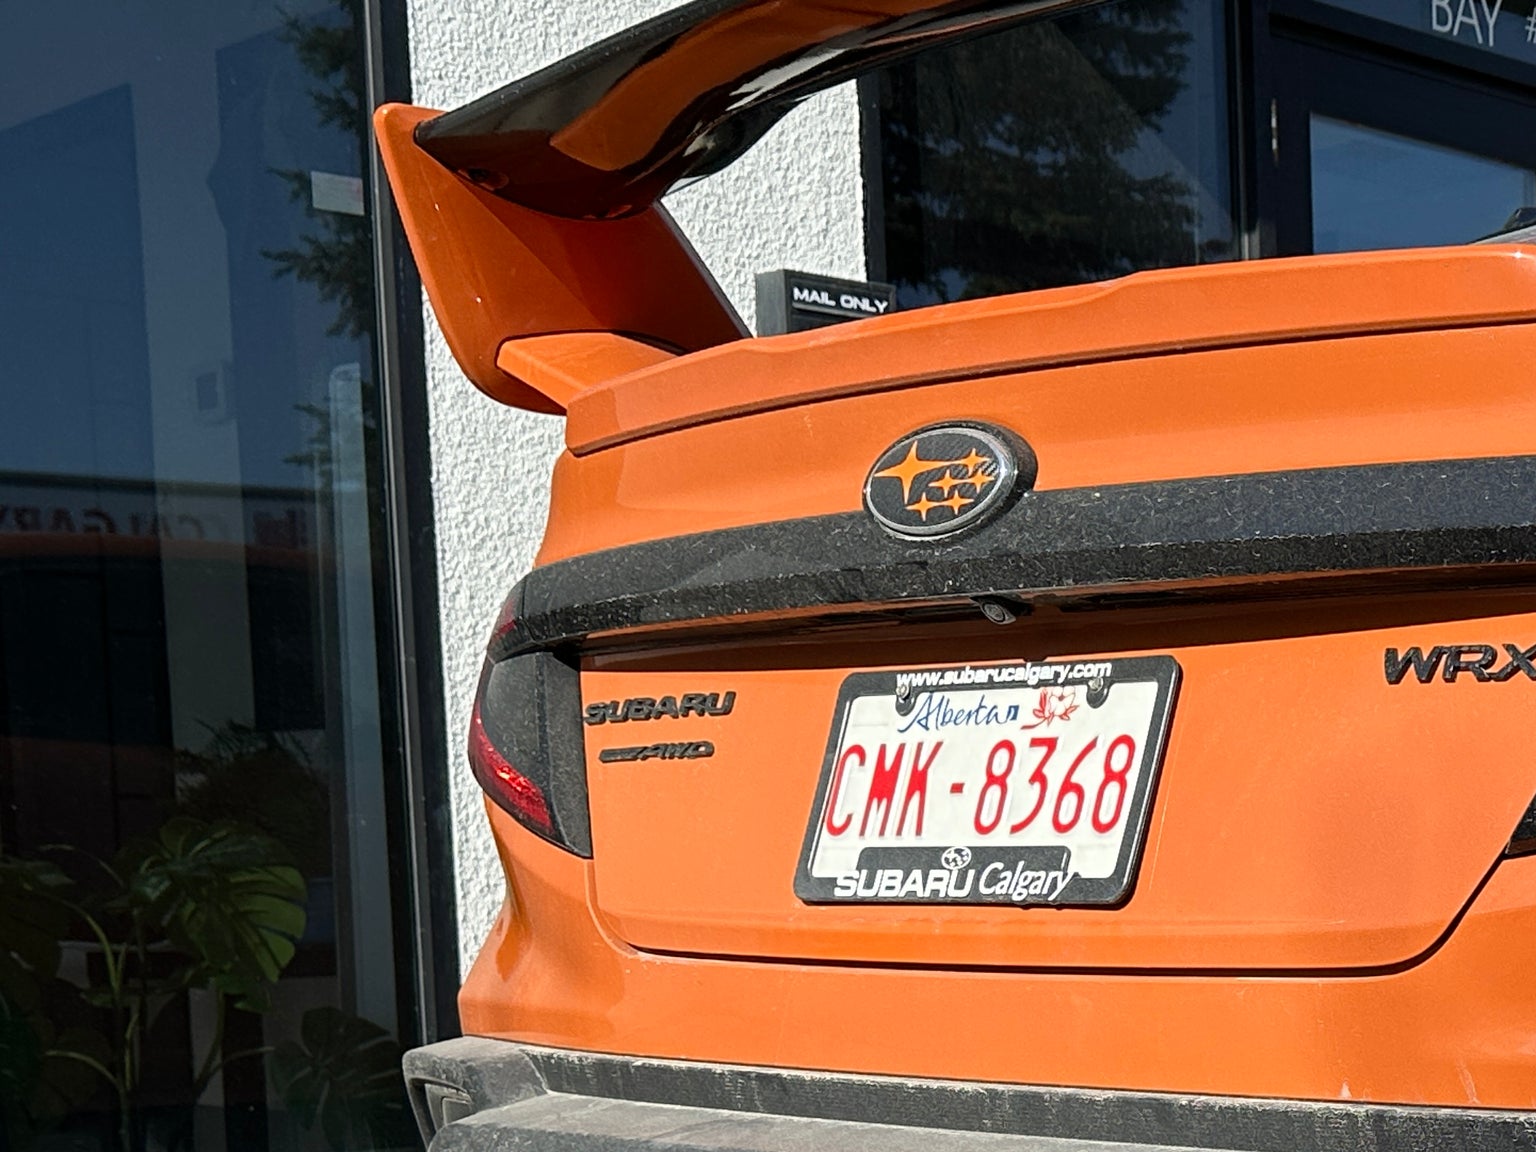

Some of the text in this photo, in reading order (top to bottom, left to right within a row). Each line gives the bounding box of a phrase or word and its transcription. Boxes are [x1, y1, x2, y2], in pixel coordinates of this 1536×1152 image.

[1432, 0, 1500, 47] BAY
[792, 287, 888, 313] MAIL ONLY
[896, 662, 1113, 688] www.subarucalgary.com
[584, 691, 737, 726] SUBARU
[897, 692, 1013, 733] Alberta
[637, 741, 715, 761] AWD
[824, 734, 1136, 838] CMK-8368
[834, 861, 1073, 900] SUBARU Calgary
